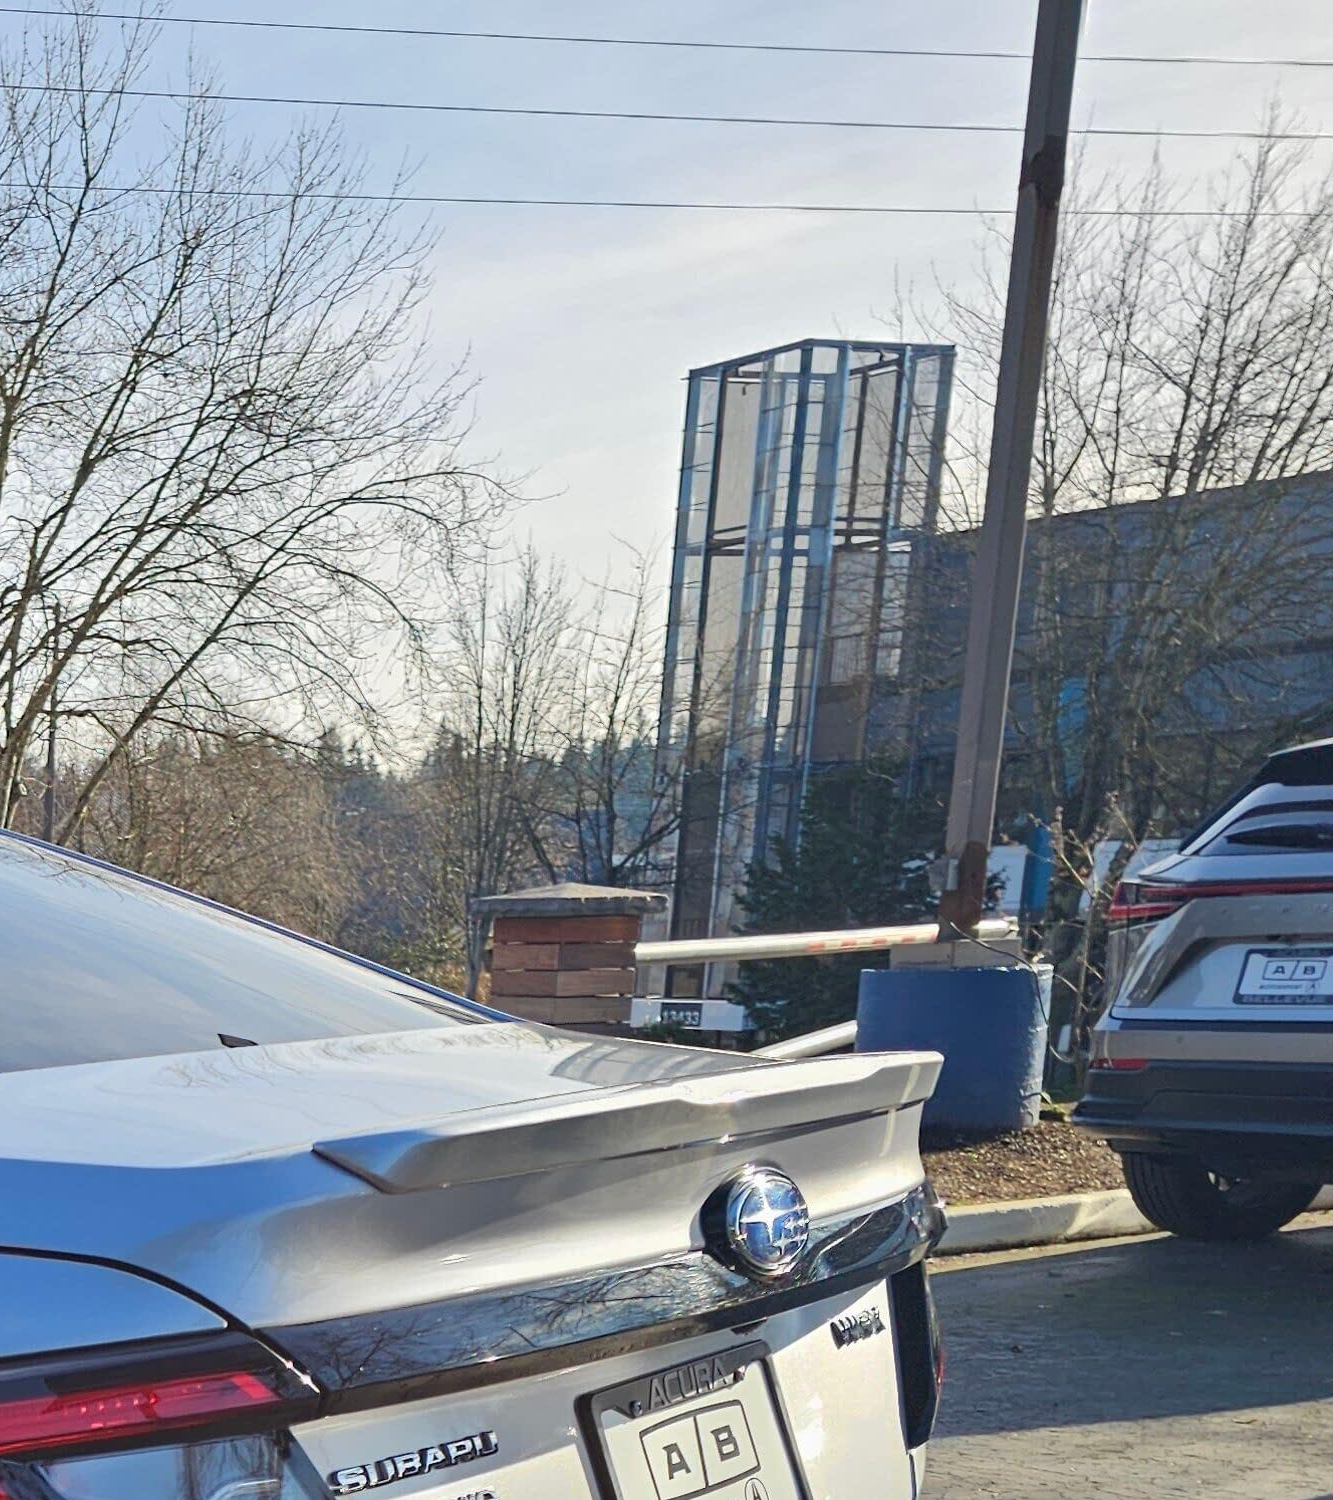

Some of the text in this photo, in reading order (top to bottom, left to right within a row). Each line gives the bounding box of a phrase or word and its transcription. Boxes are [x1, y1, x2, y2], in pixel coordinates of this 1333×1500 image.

[1273, 965, 1316, 975] A B
[648, 1358, 729, 1411] ACURA
[331, 1430, 499, 1494] SUBARU
[662, 1424, 740, 1480] A B
